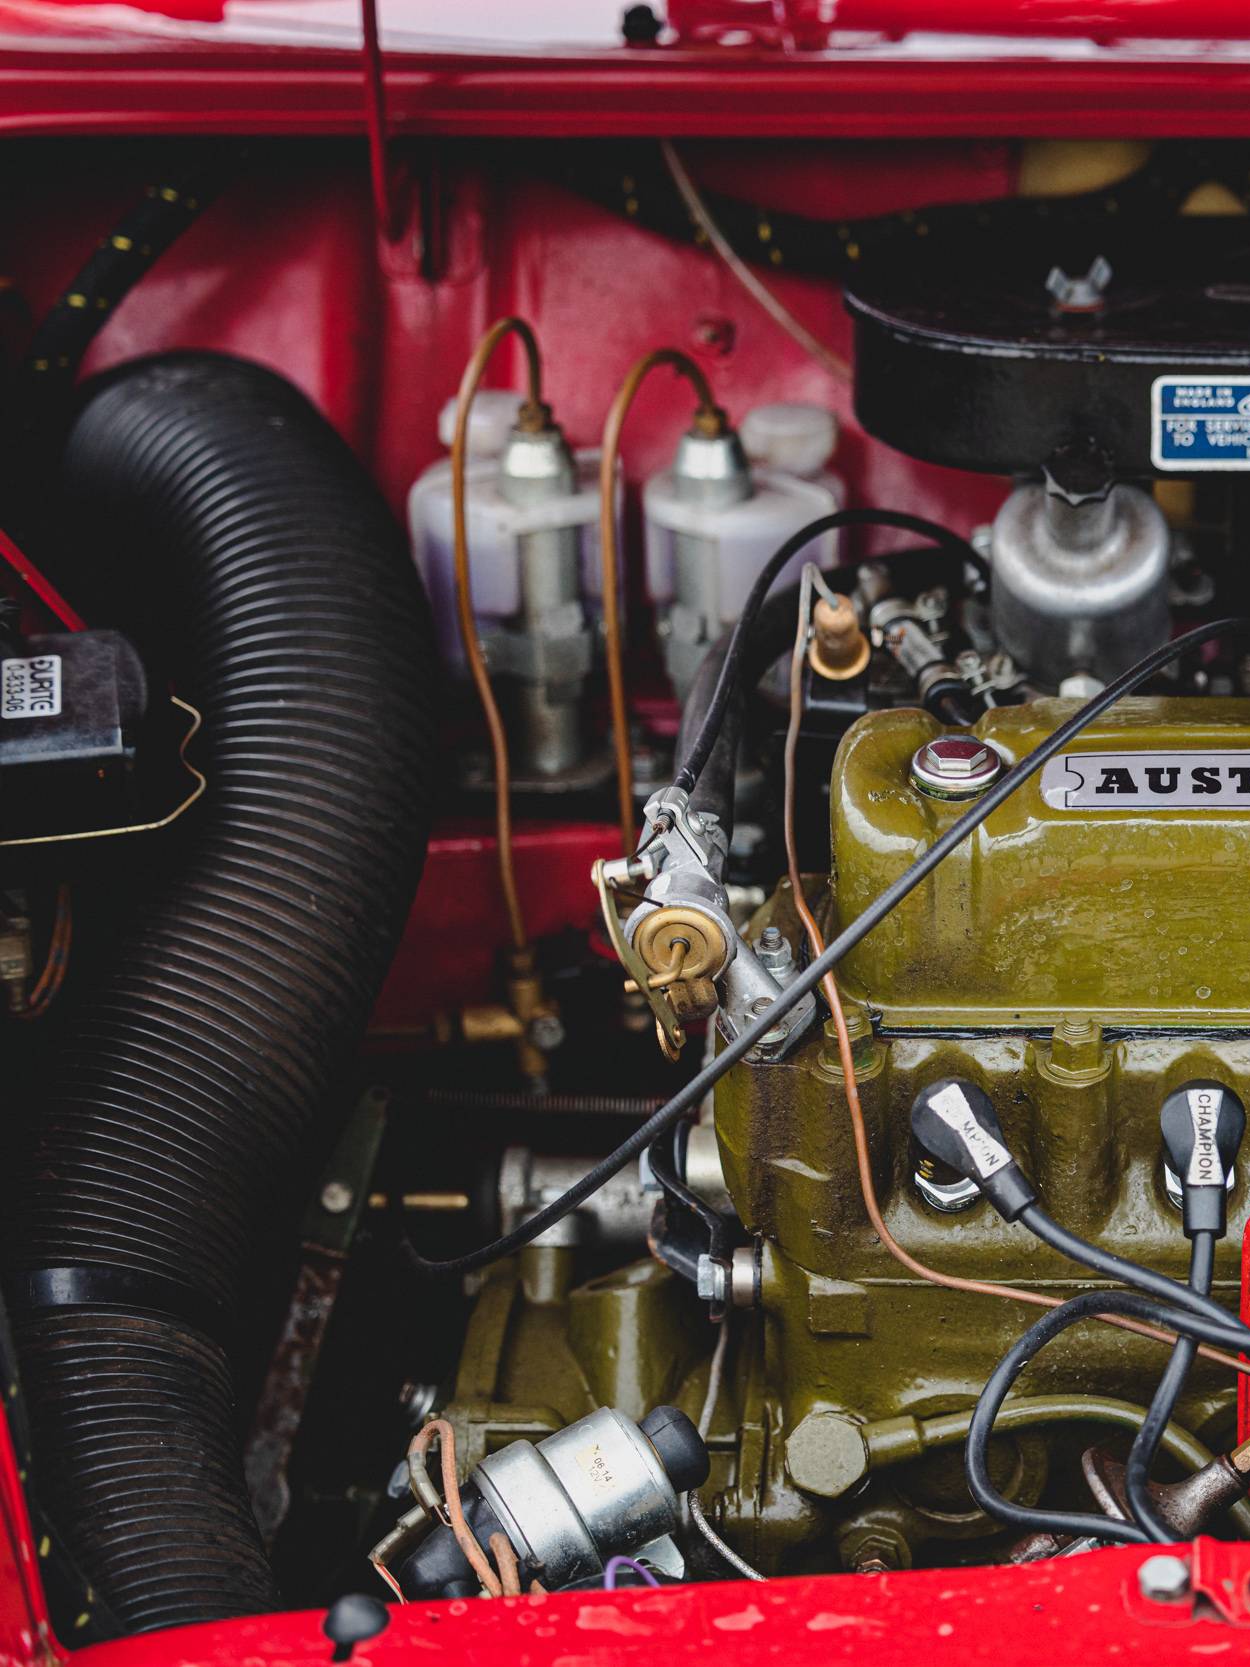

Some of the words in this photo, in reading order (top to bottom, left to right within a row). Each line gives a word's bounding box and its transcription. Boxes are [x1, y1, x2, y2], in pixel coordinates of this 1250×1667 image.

[1175, 387, 1212, 397] MADE
[1216, 387, 1232, 397] IN
[1173, 397, 1235, 407] ENGLAND
[1166, 420, 1197, 433] FOR
[1173, 433, 1195, 446] TO
[30, 660, 55, 711] DURITE
[1197, 1094, 1212, 1180] CHAMPION
[594, 1457, 605, 1469] 06
